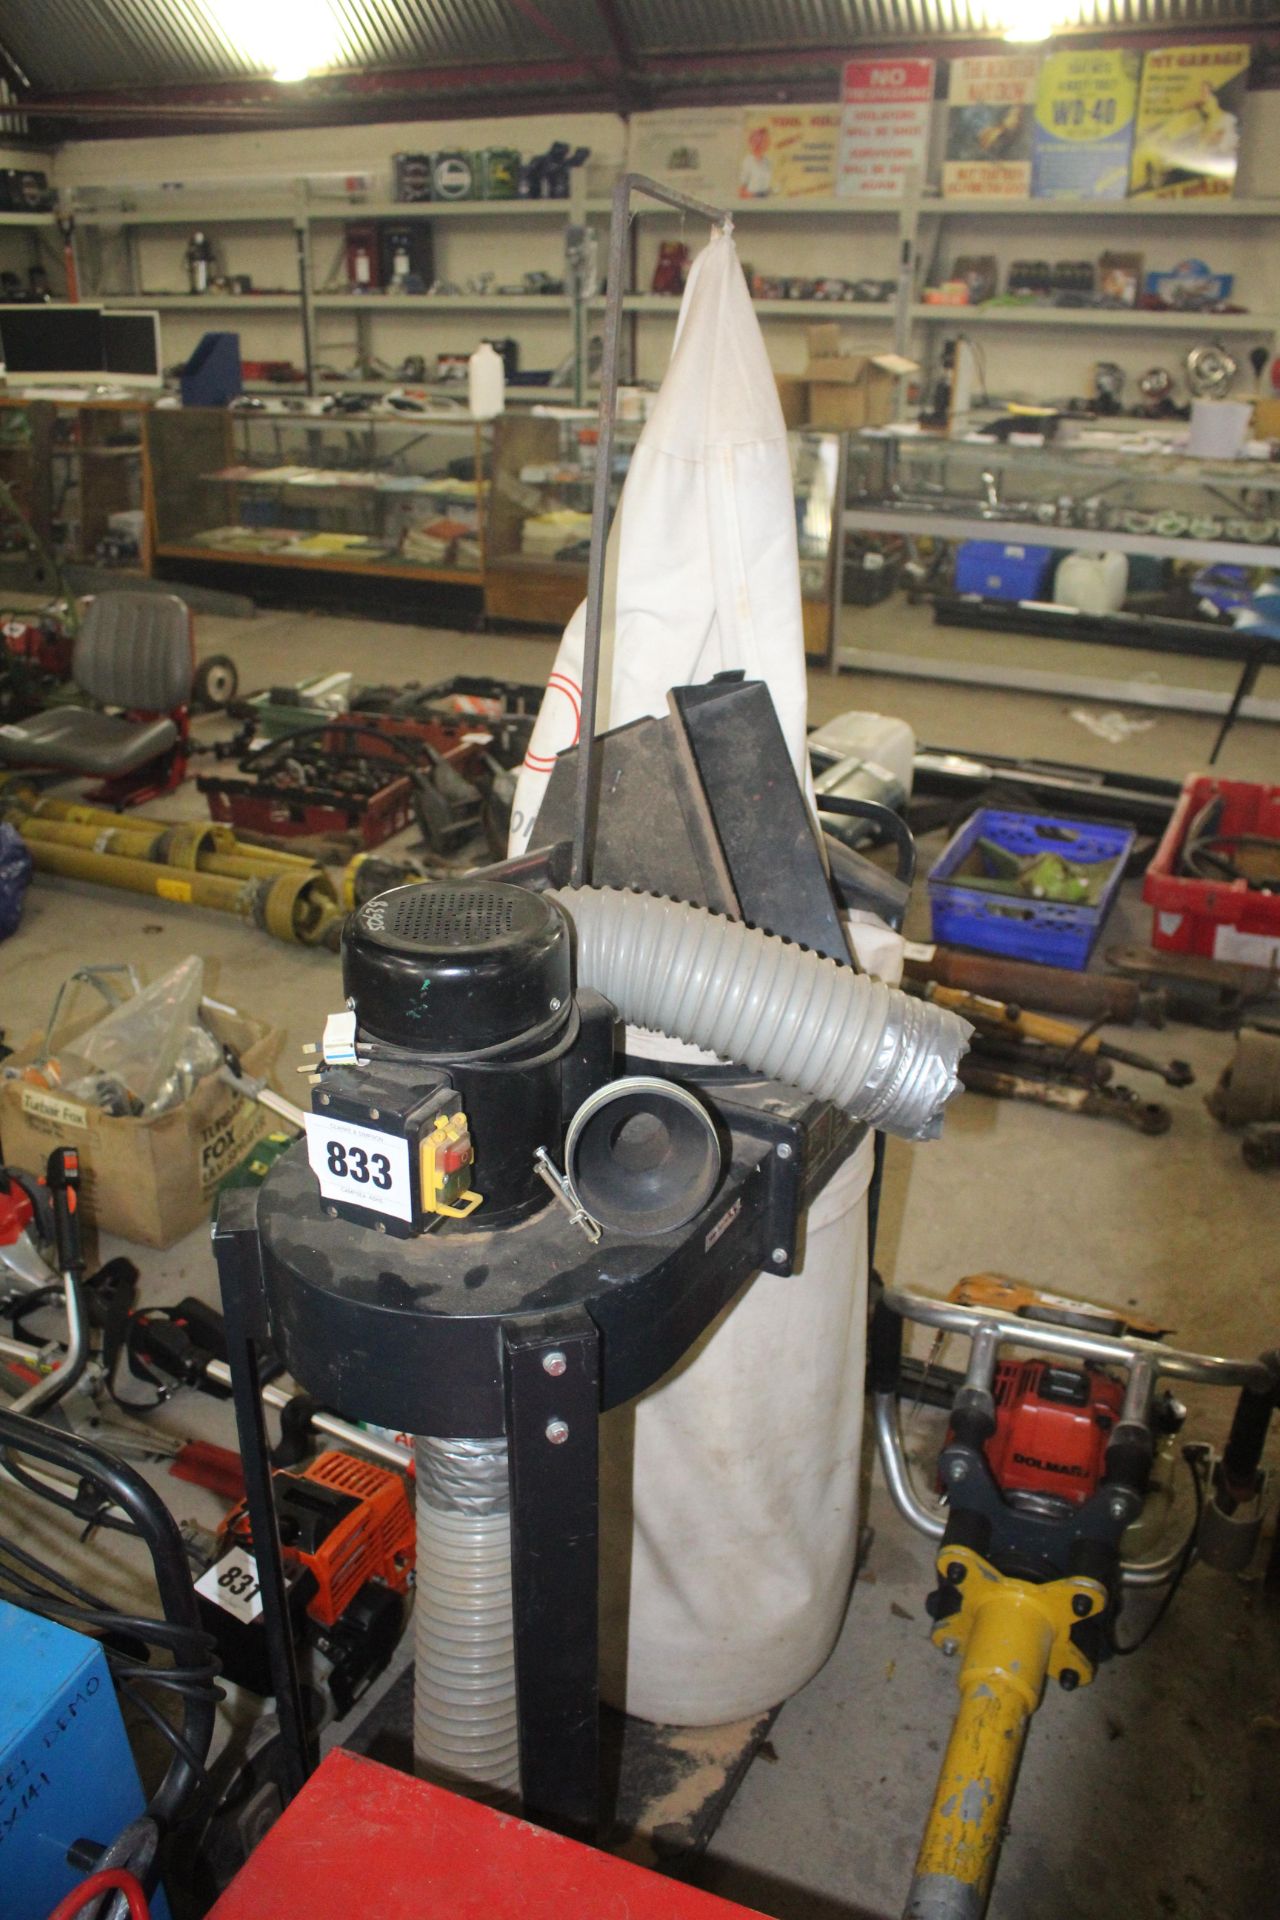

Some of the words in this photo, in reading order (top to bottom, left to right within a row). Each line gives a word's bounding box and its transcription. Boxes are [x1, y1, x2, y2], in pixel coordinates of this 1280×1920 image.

[870, 68, 906, 86] NO
[1053, 99, 1116, 126] WD-40
[202, 1130, 236, 1169] FOX
[326, 1140, 393, 1190] 833
[217, 1566, 260, 1603] 831
[43, 1676, 100, 1749] DEMO
